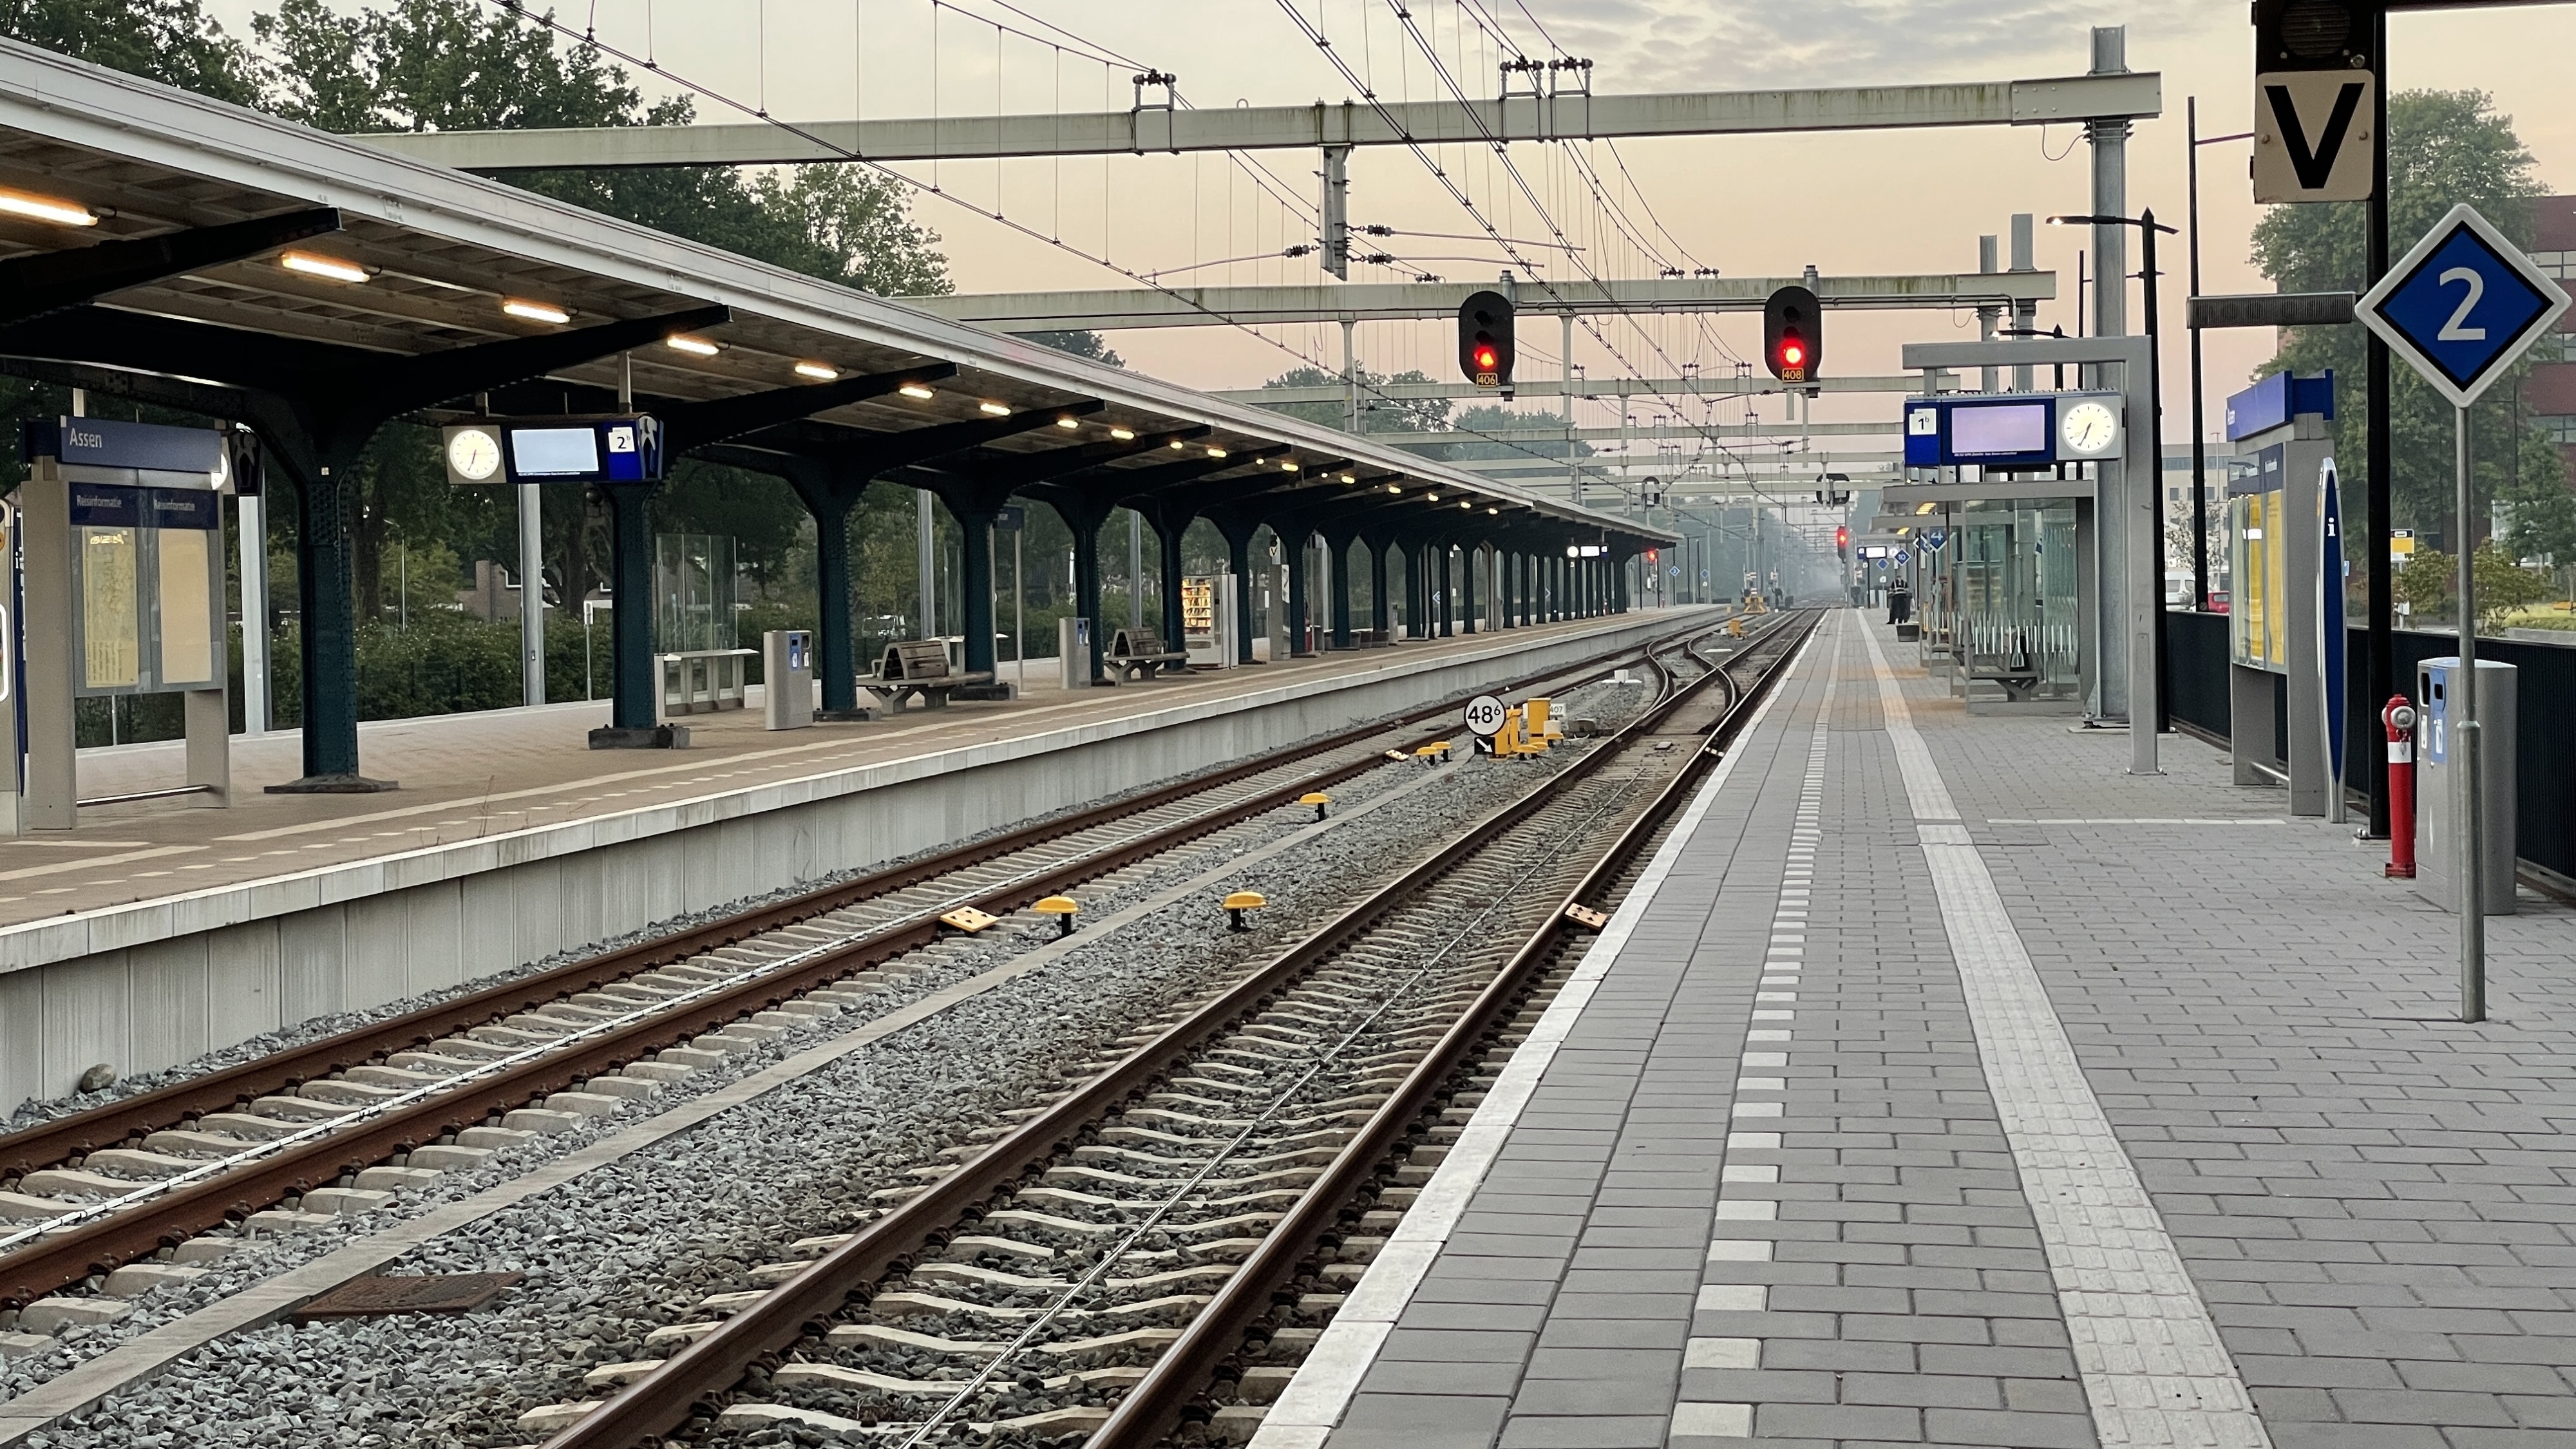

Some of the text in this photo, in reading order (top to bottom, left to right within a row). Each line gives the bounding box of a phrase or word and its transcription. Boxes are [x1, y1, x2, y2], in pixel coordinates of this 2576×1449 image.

[2264, 82, 2365, 189] V
[2438, 267, 2486, 341] 2
[1479, 375, 1495, 385] 406
[1784, 370, 1802, 380] 408
[69, 428, 102, 448] Assen
[76, 495, 122, 508] Reisinformatie
[153, 498, 196, 511] Reisinformatie
[1930, 529, 1944, 542] 4
